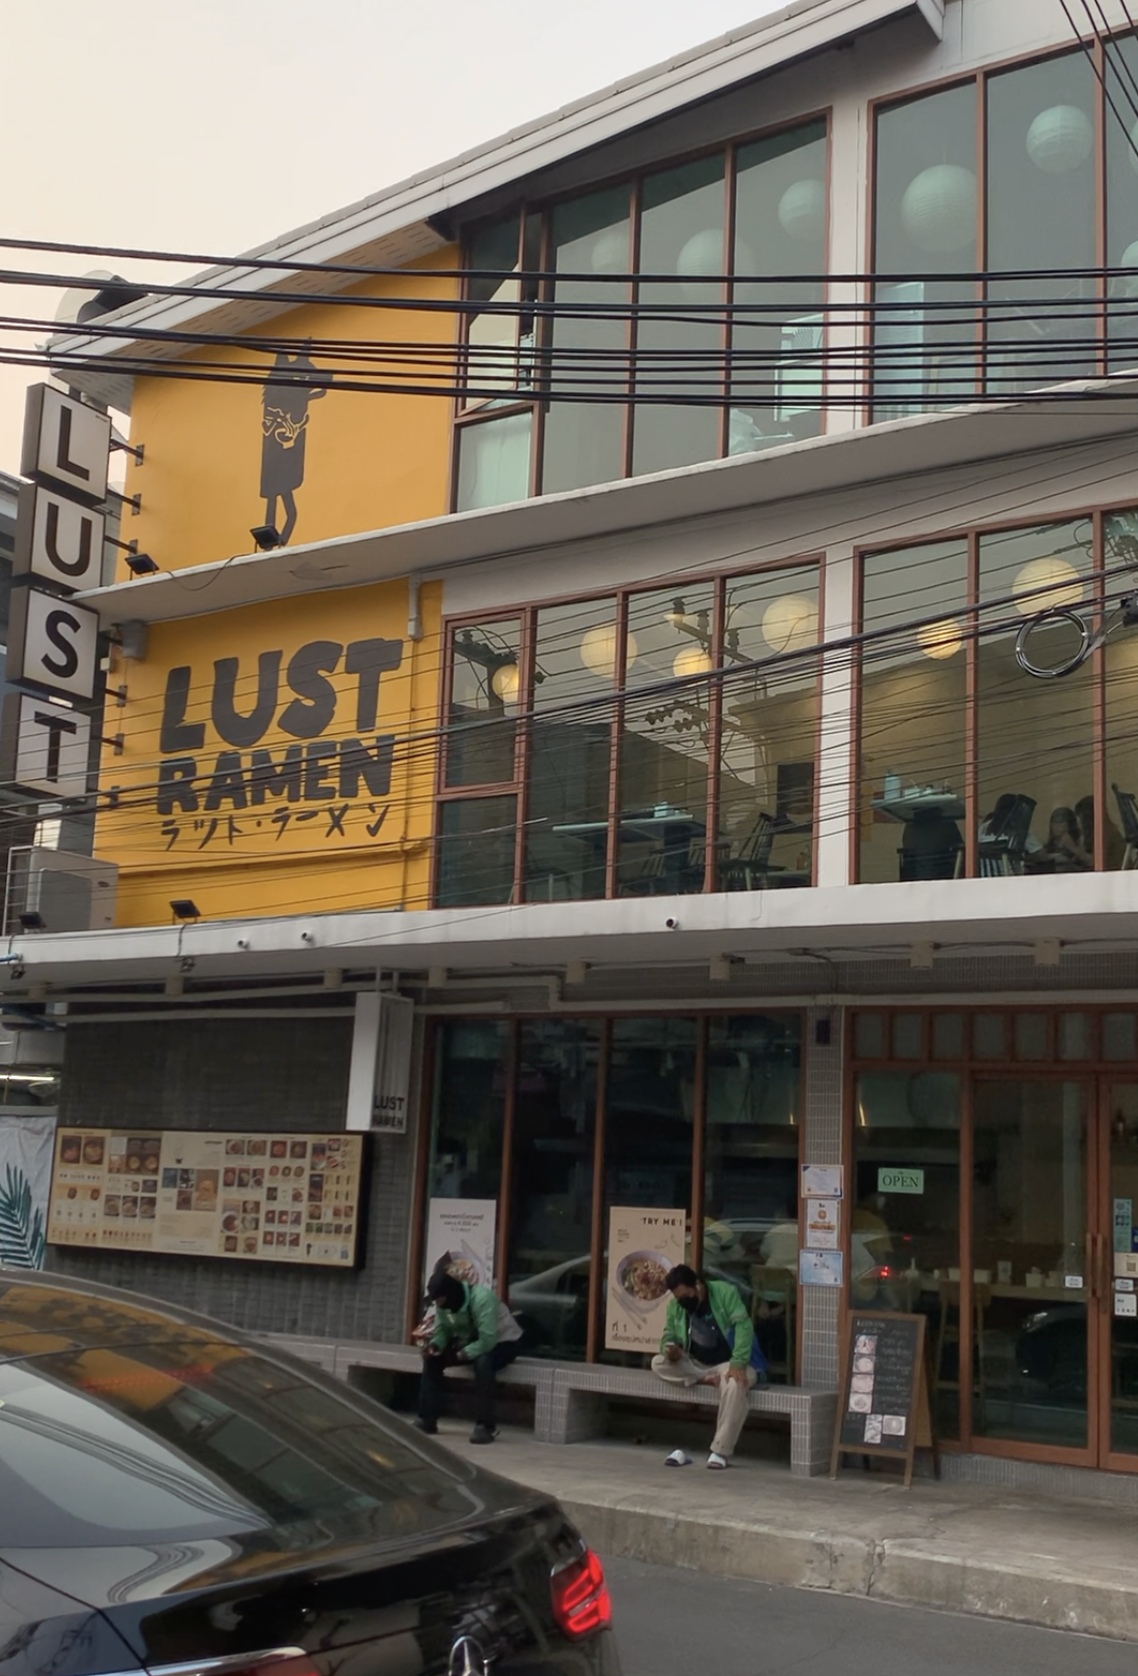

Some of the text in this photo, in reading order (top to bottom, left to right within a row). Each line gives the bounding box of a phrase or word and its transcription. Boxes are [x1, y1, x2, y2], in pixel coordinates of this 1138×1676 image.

[34, 405, 93, 783] LUST
[159, 638, 404, 753] LUST
[157, 734, 396, 815] RAMEN
[373, 1095, 405, 1111] LUST
[882, 1174, 919, 1188] OPEN
[643, 1217, 659, 1226] TRY
